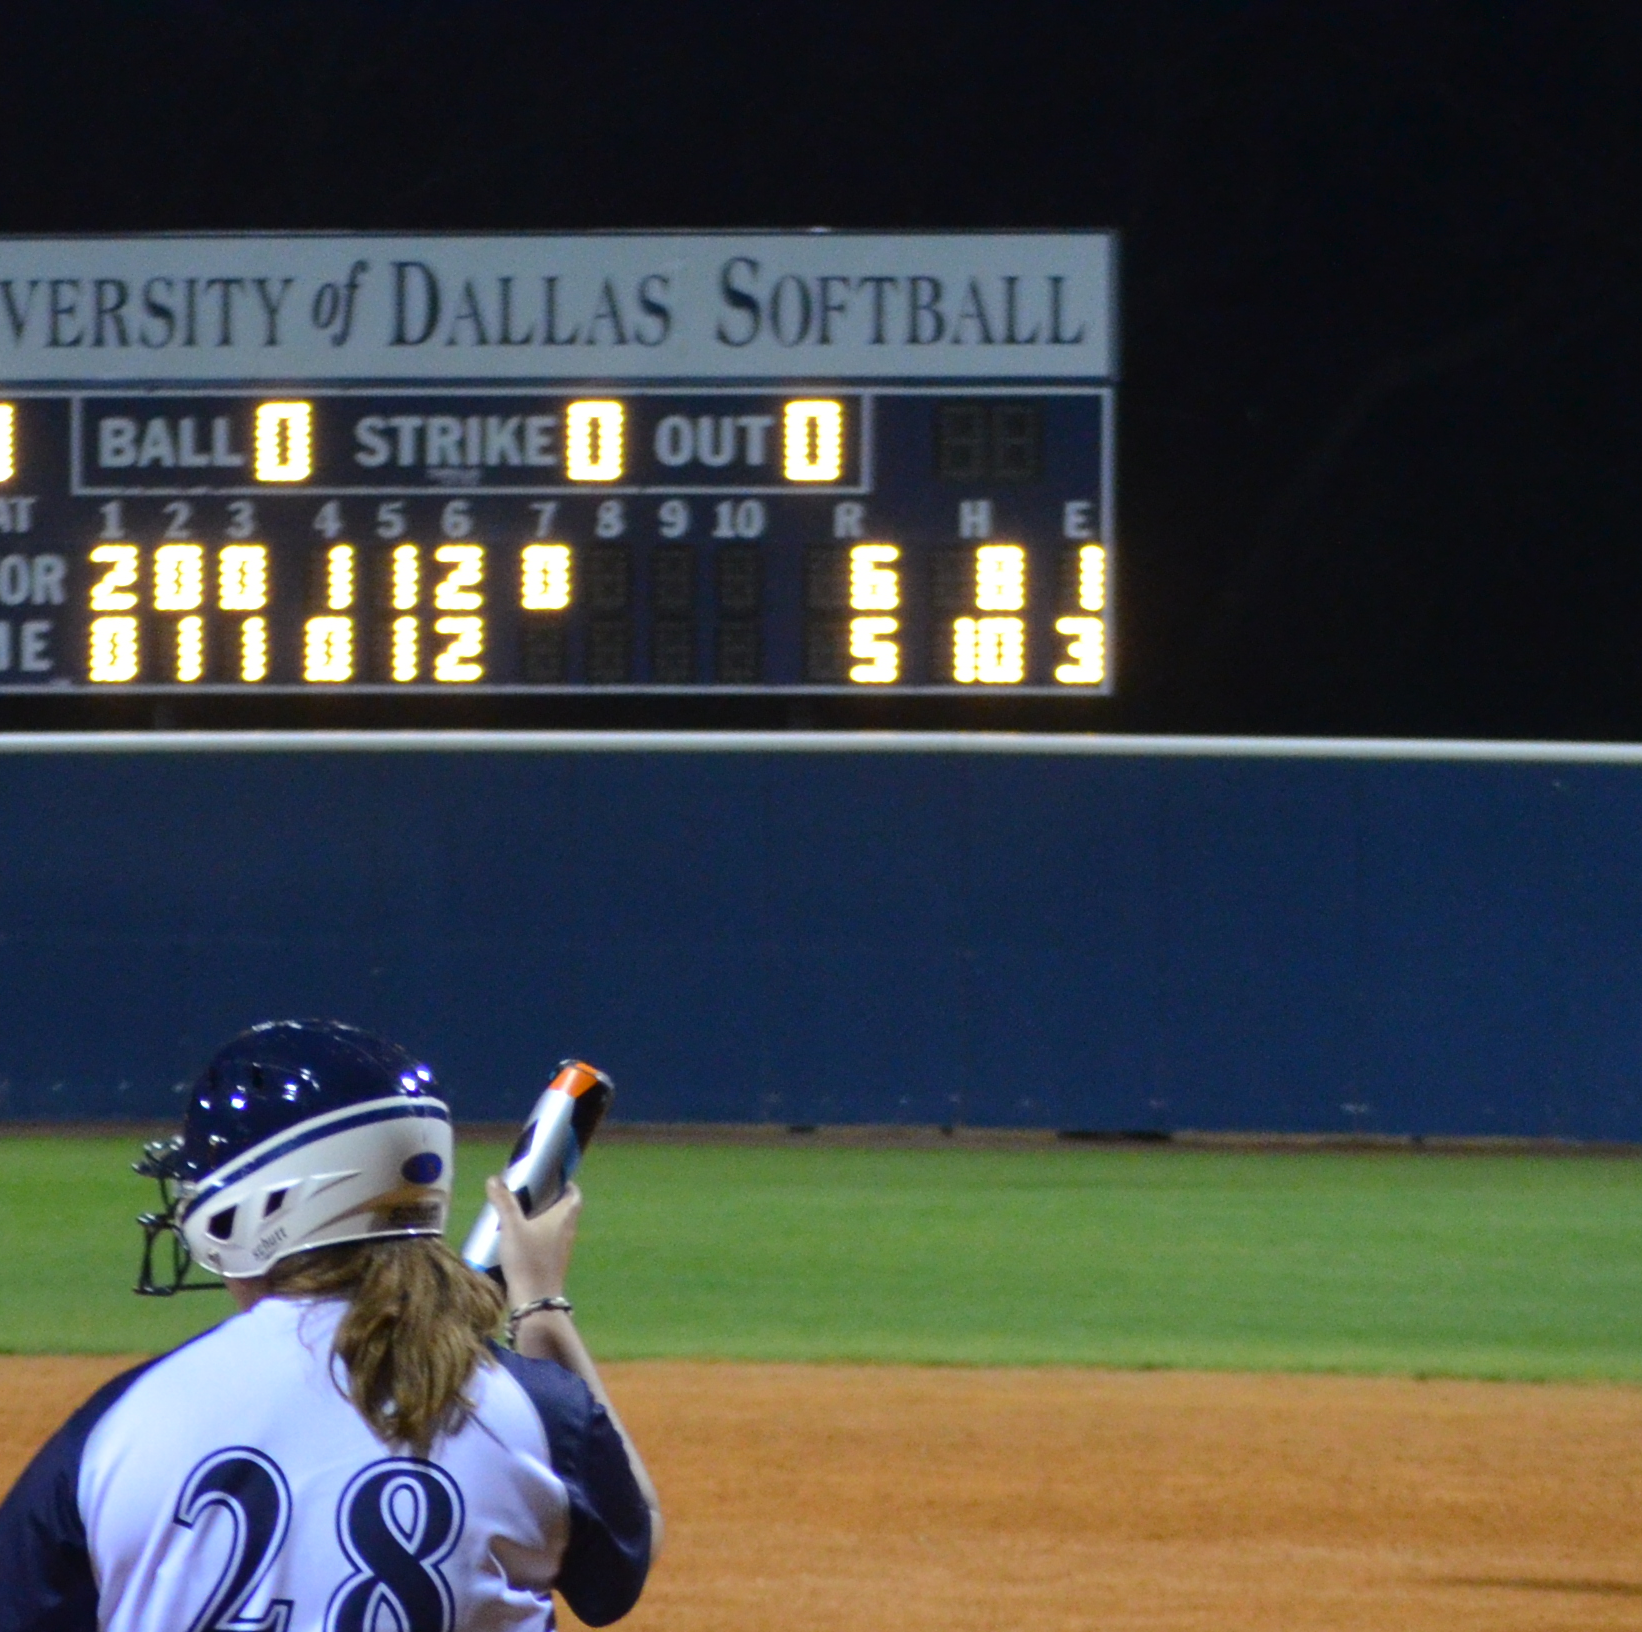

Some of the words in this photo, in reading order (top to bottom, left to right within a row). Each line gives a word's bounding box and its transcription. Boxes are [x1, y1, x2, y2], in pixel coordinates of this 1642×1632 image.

[311, 259, 370, 347] of
[389, 259, 673, 348] DALLAS
[715, 255, 1085, 348] SOFTBALL
[97, 415, 246, 469] BALL
[254, 400, 312, 483] 0
[354, 414, 558, 468] STRIKE
[565, 399, 625, 483] 0
[654, 414, 775, 468] OUT
[783, 399, 843, 483] 0
[99, 501, 126, 540] 1
[161, 500, 193, 540] 2
[225, 500, 255, 540] 3
[313, 500, 343, 540] 4
[375, 500, 407, 539] 5
[440, 500, 473, 539] 6
[529, 500, 559, 539] 7
[593, 500, 626, 539] 8
[658, 500, 690, 539] 9
[711, 500, 766, 539] 10
[833, 500, 865, 539] R
[959, 499, 993, 539] H
[1063, 500, 1094, 539] E
[88, 543, 139, 612] 2
[153, 543, 205, 612] 0
[218, 543, 268, 612] 0
[326, 543, 354, 611] 1
[391, 543, 420, 611] 1
[434, 543, 485, 612] 2
[849, 543, 901, 612] 6
[975, 543, 1026, 612] 8
[1078, 543, 1107, 612] 1
[88, 614, 139, 683] 0
[176, 614, 205, 683] 1
[241, 614, 269, 683] 1
[303, 614, 354, 683] 0
[391, 614, 420, 683] 1
[434, 614, 485, 683] 2
[849, 615, 900, 684] 5
[953, 615, 1026, 684] 10
[1054, 613, 1107, 684] 3
